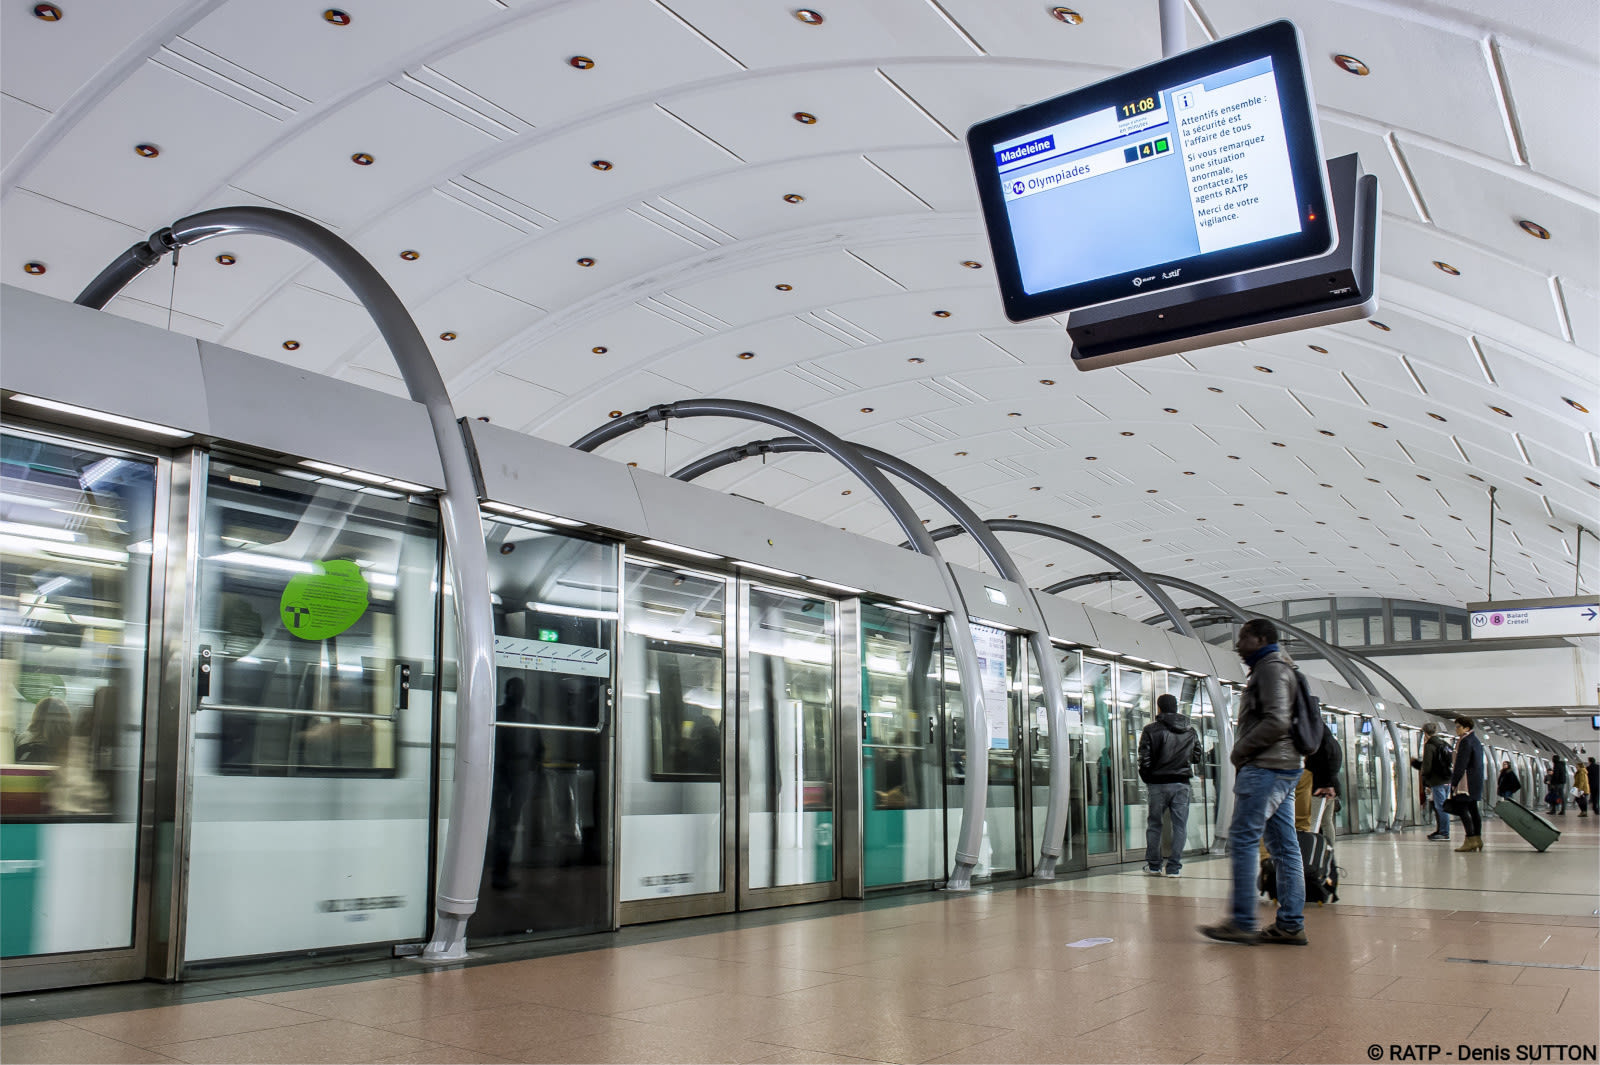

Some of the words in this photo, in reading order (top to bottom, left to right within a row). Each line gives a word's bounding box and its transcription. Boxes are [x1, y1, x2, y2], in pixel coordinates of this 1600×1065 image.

[1122, 97, 1155, 117] 11:08
[1181, 109, 1219, 126] Attentifs
[1220, 96, 1262, 114] ensemble
[1182, 129, 1191, 137] la
[1192, 117, 1226, 135] sécurité
[1228, 113, 1242, 124] est
[1184, 133, 1218, 148] l'affaire
[1219, 129, 1231, 138] de
[1232, 122, 1252, 134] tous
[1000, 140, 1051, 163] Madeleine
[1142, 145, 1151, 155] 4
[1187, 153, 1197, 162] Si
[1197, 147, 1218, 159] vous
[1219, 135, 1265, 154] remarquez
[1189, 162, 1207, 173] une
[1207, 151, 1246, 168] situation
[1014, 182, 1024, 192] 14
[1028, 164, 1091, 190] Olympiades
[1191, 166, 1234, 183] anormale,
[1193, 175, 1234, 193] contactez
[1235, 172, 1249, 182] les
[1195, 190, 1223, 204] agents
[1225, 182, 1249, 196] RATP
[1197, 204, 1222, 217] Merci
[1223, 202, 1235, 212] de
[1236, 196, 1259, 208] votre
[1199, 212, 1240, 228] vigilance.
